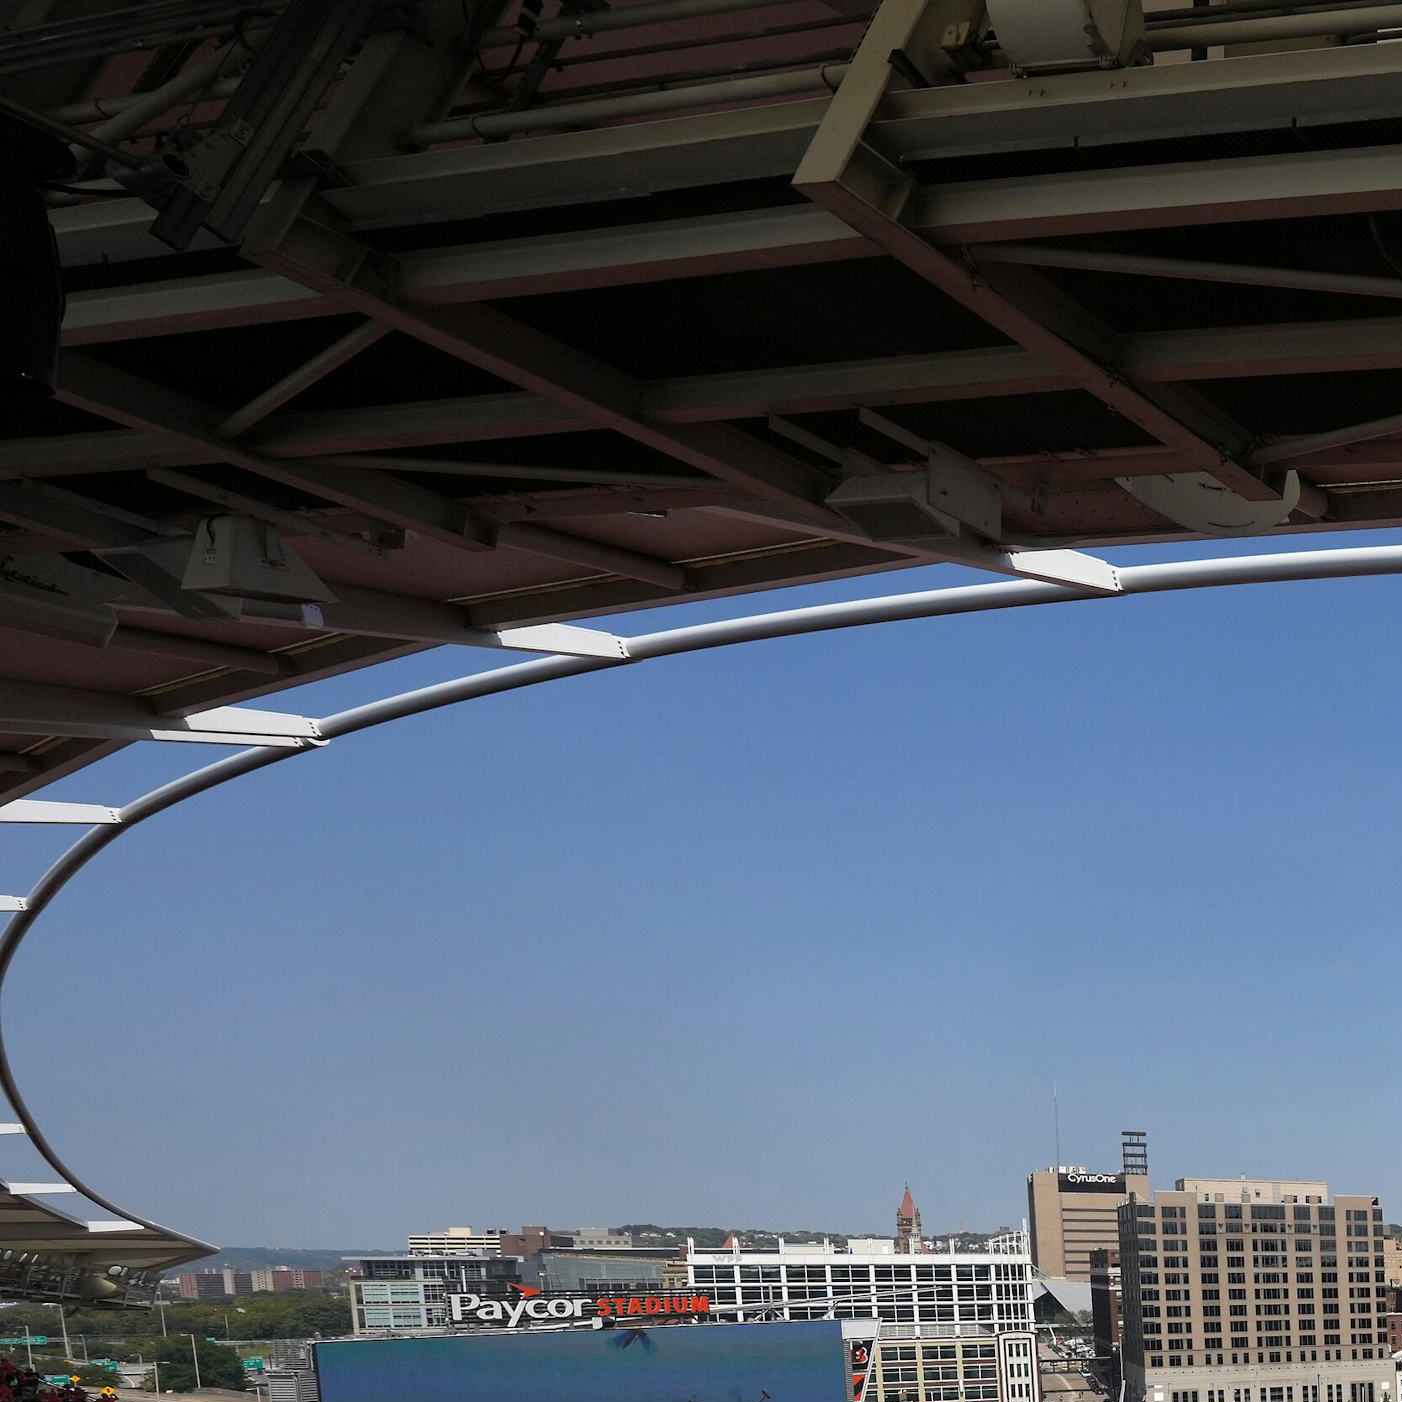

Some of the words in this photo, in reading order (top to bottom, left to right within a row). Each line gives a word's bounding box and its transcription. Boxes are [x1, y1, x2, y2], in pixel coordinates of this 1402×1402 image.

[1068, 1172, 1117, 1184] CyrusOne
[450, 1293, 592, 1328] Paycor
[596, 1296, 710, 1317] STADIUM
